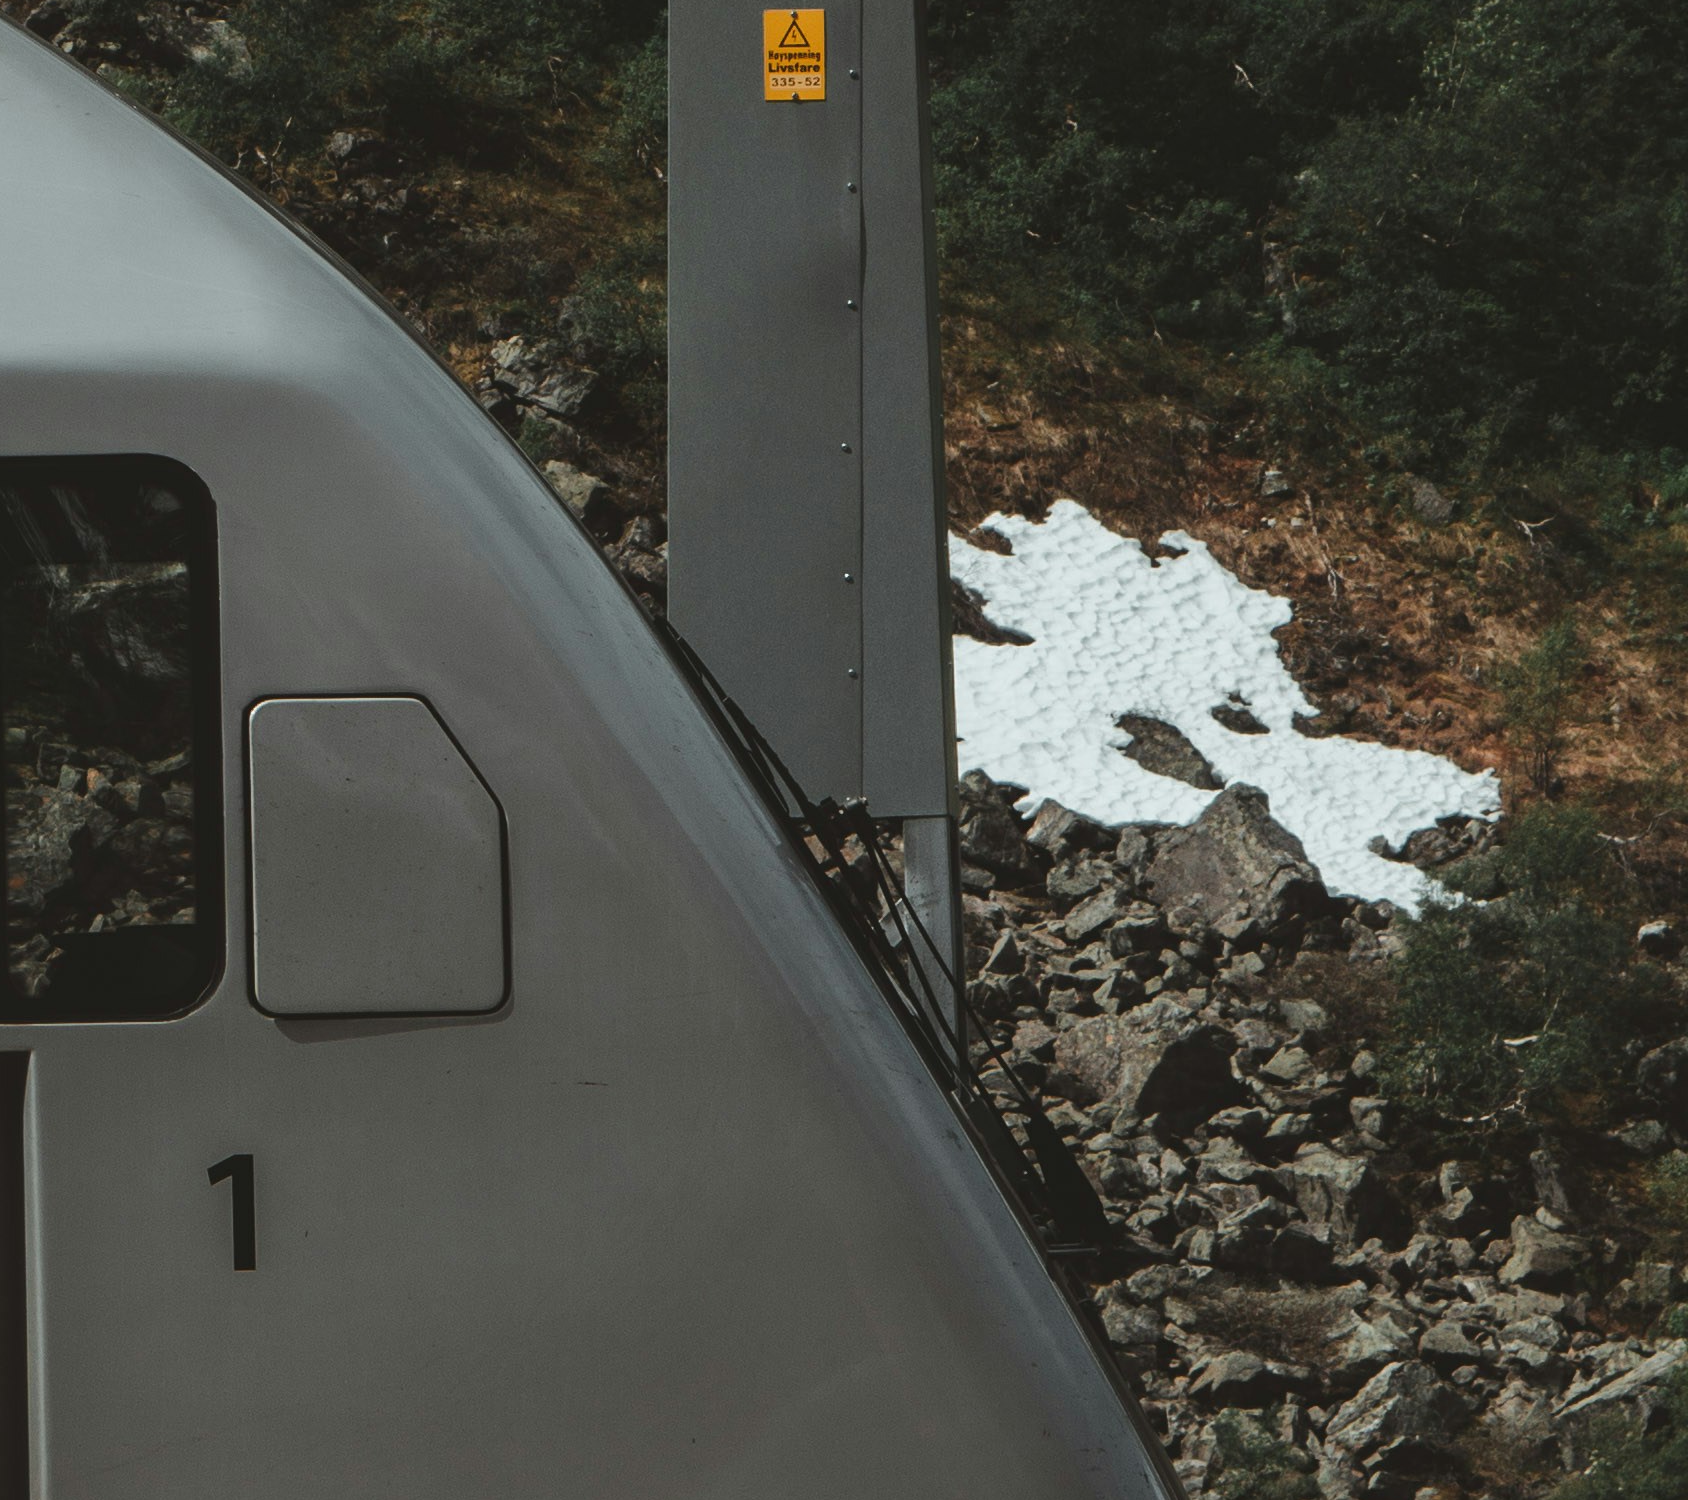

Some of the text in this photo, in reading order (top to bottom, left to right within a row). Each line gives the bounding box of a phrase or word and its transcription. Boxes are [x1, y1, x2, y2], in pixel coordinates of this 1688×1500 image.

[768, 62, 820, 73] Livsfare
[771, 77, 820, 87] 335-52
[207, 1154, 256, 1271] 1
